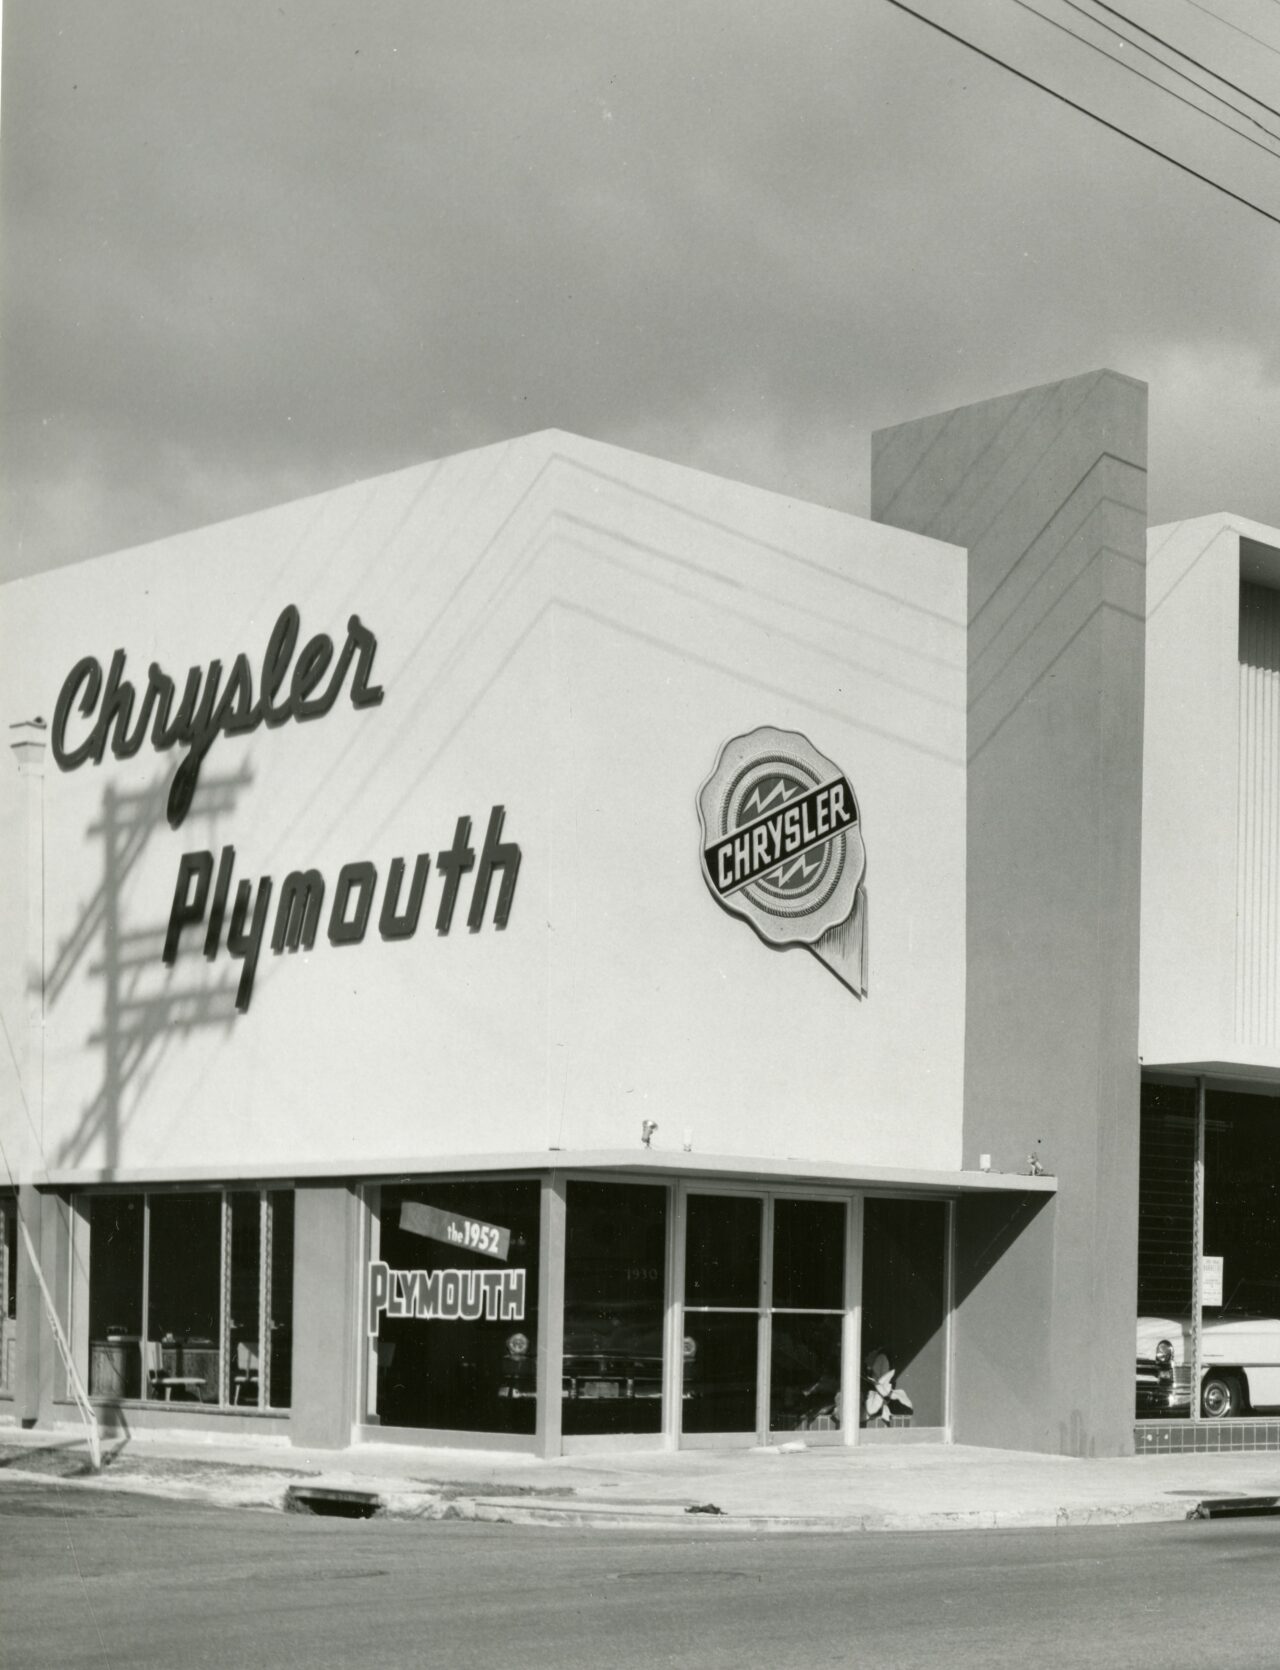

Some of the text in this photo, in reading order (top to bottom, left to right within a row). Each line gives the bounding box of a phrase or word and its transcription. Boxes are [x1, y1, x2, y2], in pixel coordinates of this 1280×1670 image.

[51, 603, 384, 830] Chrysler
[162, 804, 522, 1014] Plymouth
[717, 783, 850, 889] CHRYSLER
[447, 1221, 500, 1254] the 1952
